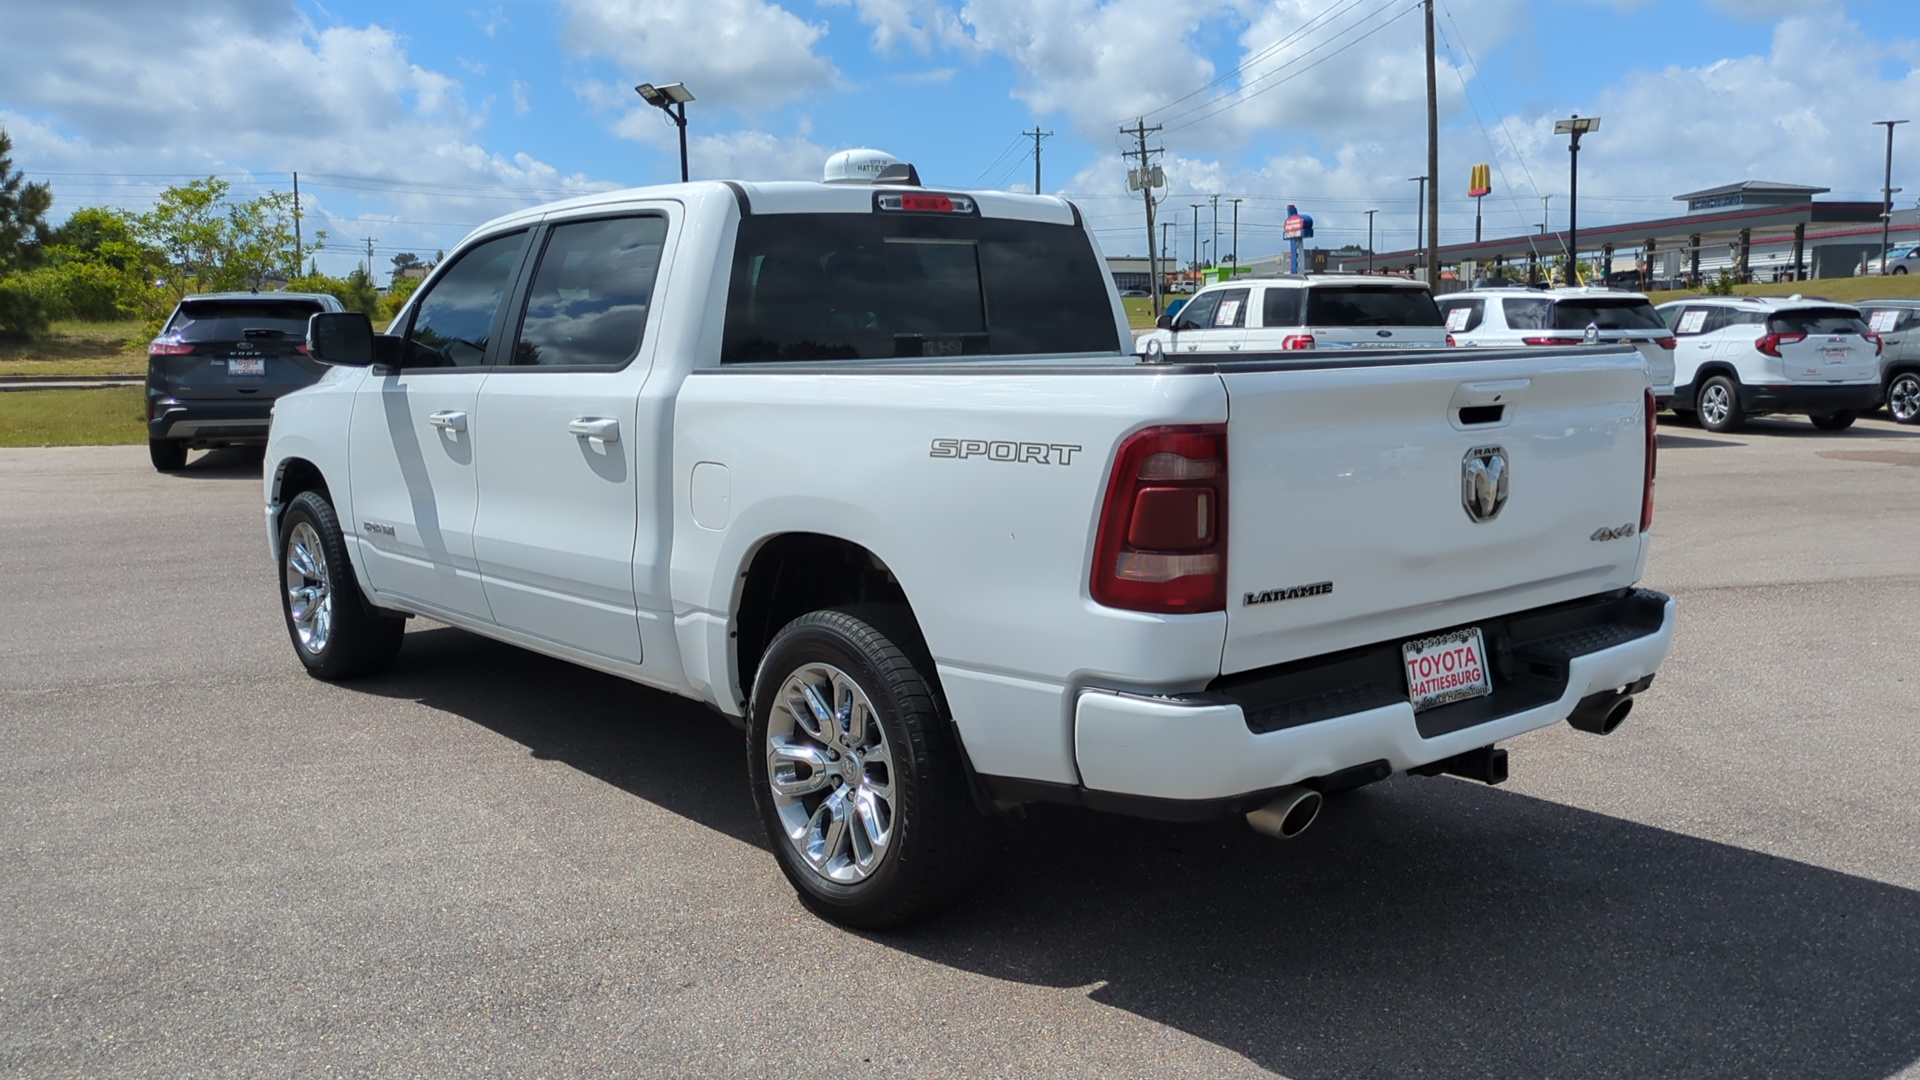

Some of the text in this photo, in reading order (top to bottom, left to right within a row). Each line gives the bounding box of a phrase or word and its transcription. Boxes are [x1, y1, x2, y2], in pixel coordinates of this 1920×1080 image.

[930, 438, 1083, 466] SPORT
[1473, 446, 1501, 456] RAM
[1243, 581, 1333, 607] LARAMIE
[1405, 627, 1479, 652] 601-544-9630
[1407, 646, 1478, 681] TOYOTA
[1411, 667, 1482, 697] HATTIESBURG
